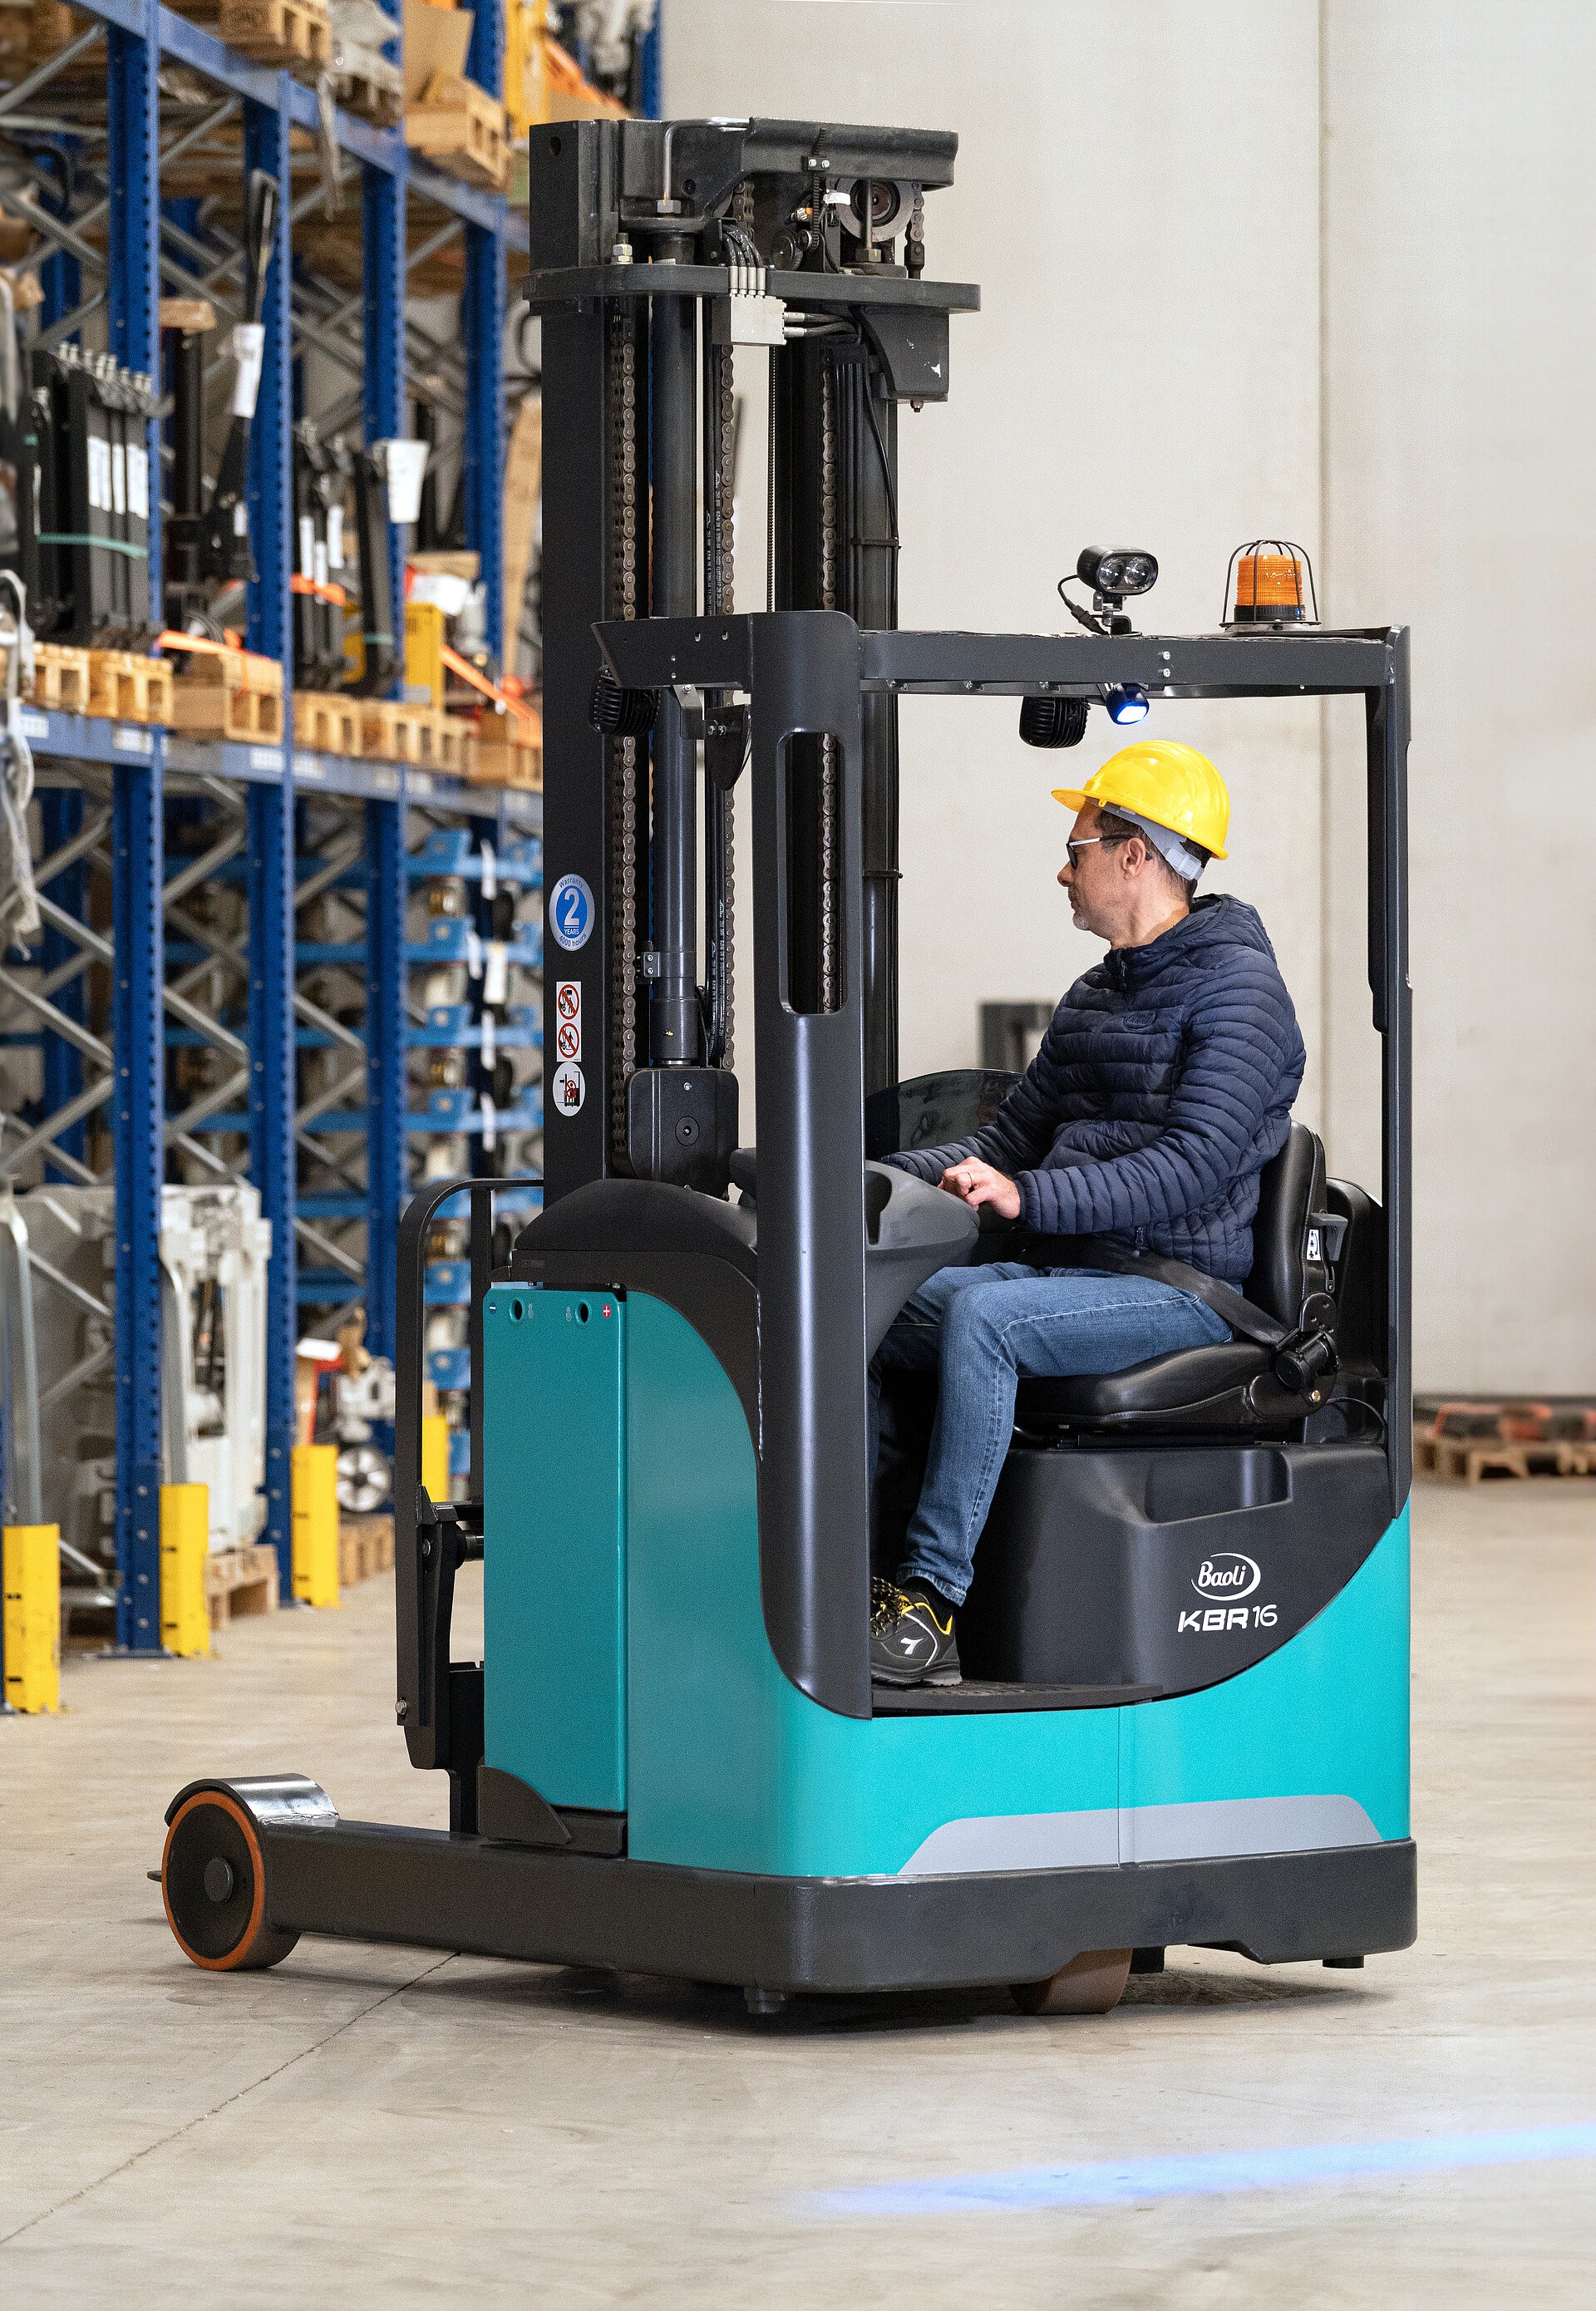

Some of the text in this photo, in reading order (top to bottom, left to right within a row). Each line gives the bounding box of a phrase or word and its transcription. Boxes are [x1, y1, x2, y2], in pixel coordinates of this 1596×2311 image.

[559, 878, 584, 889] Warranty
[564, 888, 579, 925] 2
[559, 933, 587, 948] 4000 hours
[1198, 1560, 1247, 1588] Baoli
